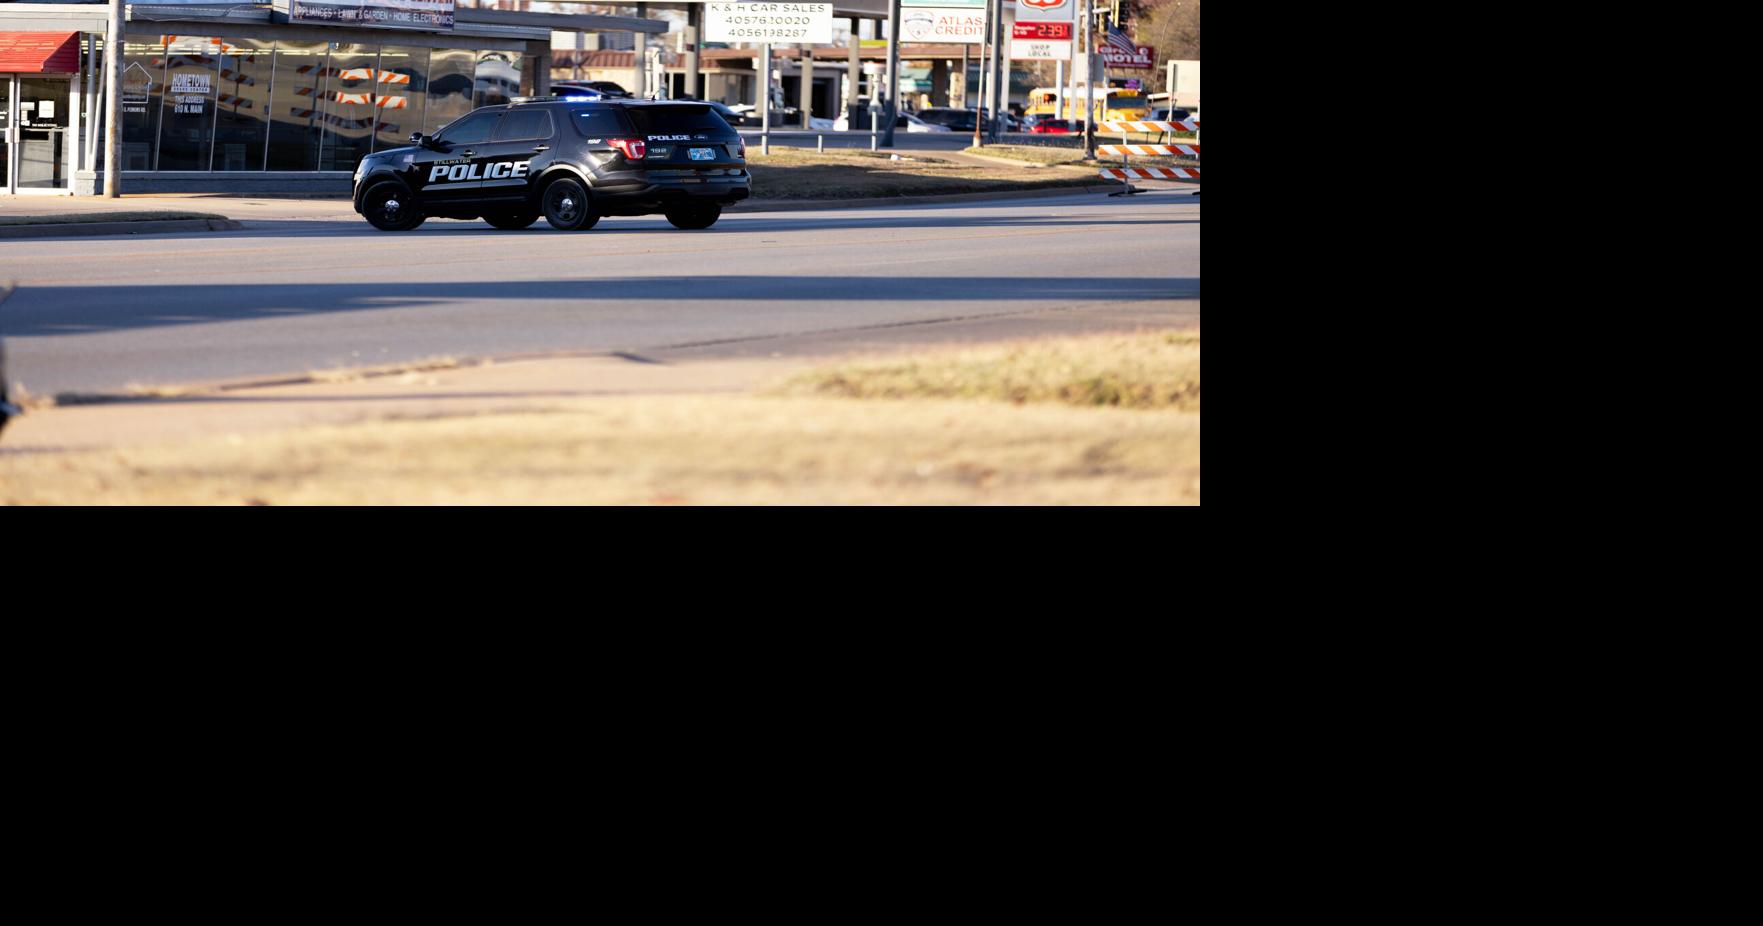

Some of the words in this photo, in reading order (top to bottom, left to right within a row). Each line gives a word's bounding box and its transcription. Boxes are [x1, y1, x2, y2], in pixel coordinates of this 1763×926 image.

[750, 4, 778, 12] CAR
[783, 4, 825, 12] SALES
[294, 6, 333, 18] APPLIANCES
[364, 10, 388, 20] GARDEN
[394, 12, 411, 22] HOME
[413, 13, 454, 25] ELECTRONICS
[939, 16, 983, 26] ATLAS
[935, 26, 983, 35] CREDIT
[1104, 54, 1152, 63] MOTEL
[172, 74, 211, 88] HOMETOWN
[429, 160, 531, 182] POLICE
